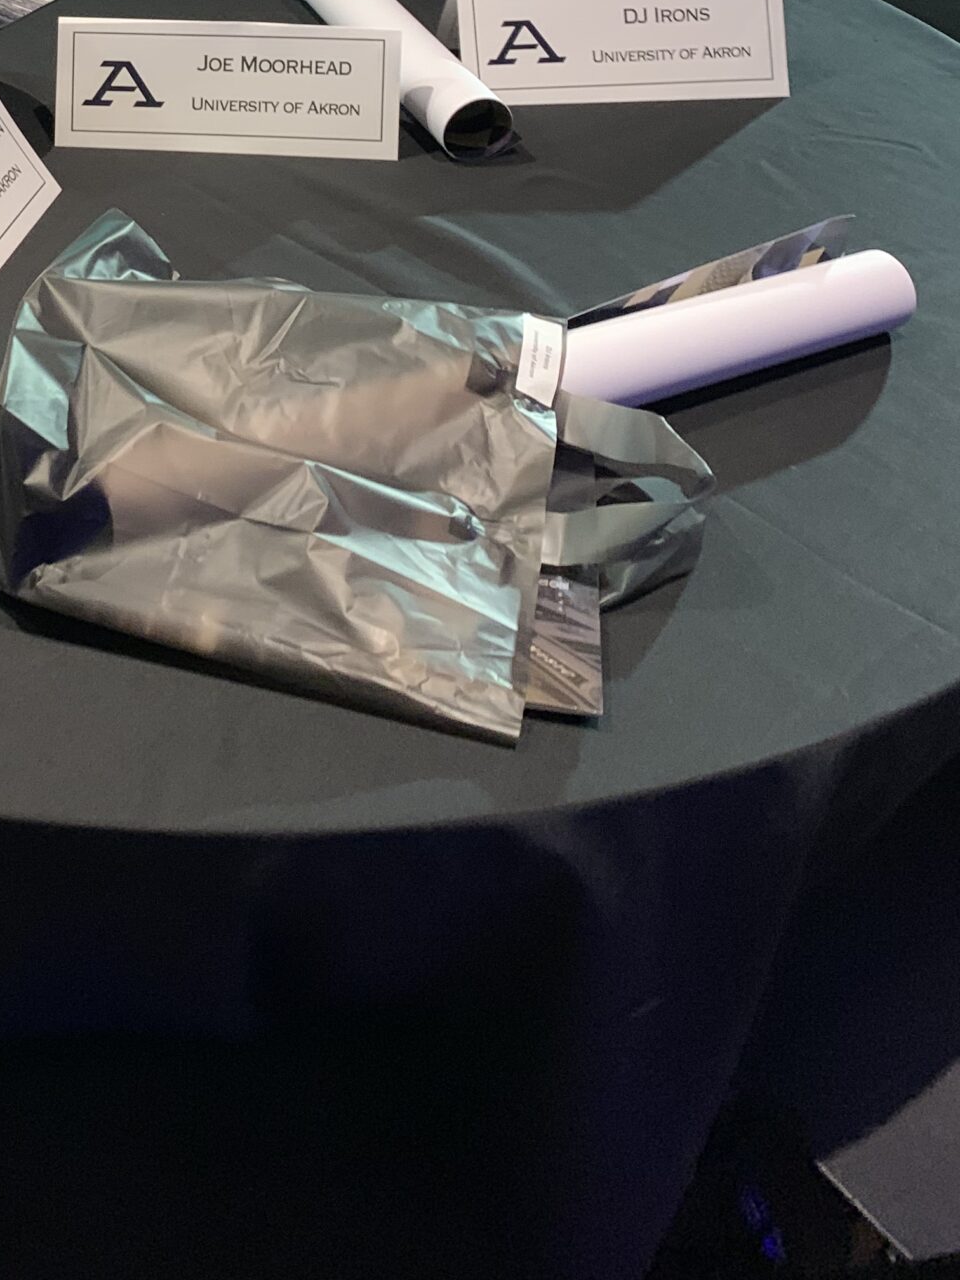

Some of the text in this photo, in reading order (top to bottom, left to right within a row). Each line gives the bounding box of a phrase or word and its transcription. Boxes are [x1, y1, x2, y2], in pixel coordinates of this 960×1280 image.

[623, 6, 711, 25] DJ IRONS
[591, 45, 752, 64] UNIVERSITY OF AKRON
[196, 54, 352, 76] JOE MOORHEAD
[190, 96, 361, 117] UNIVERSITY OF AKRON
